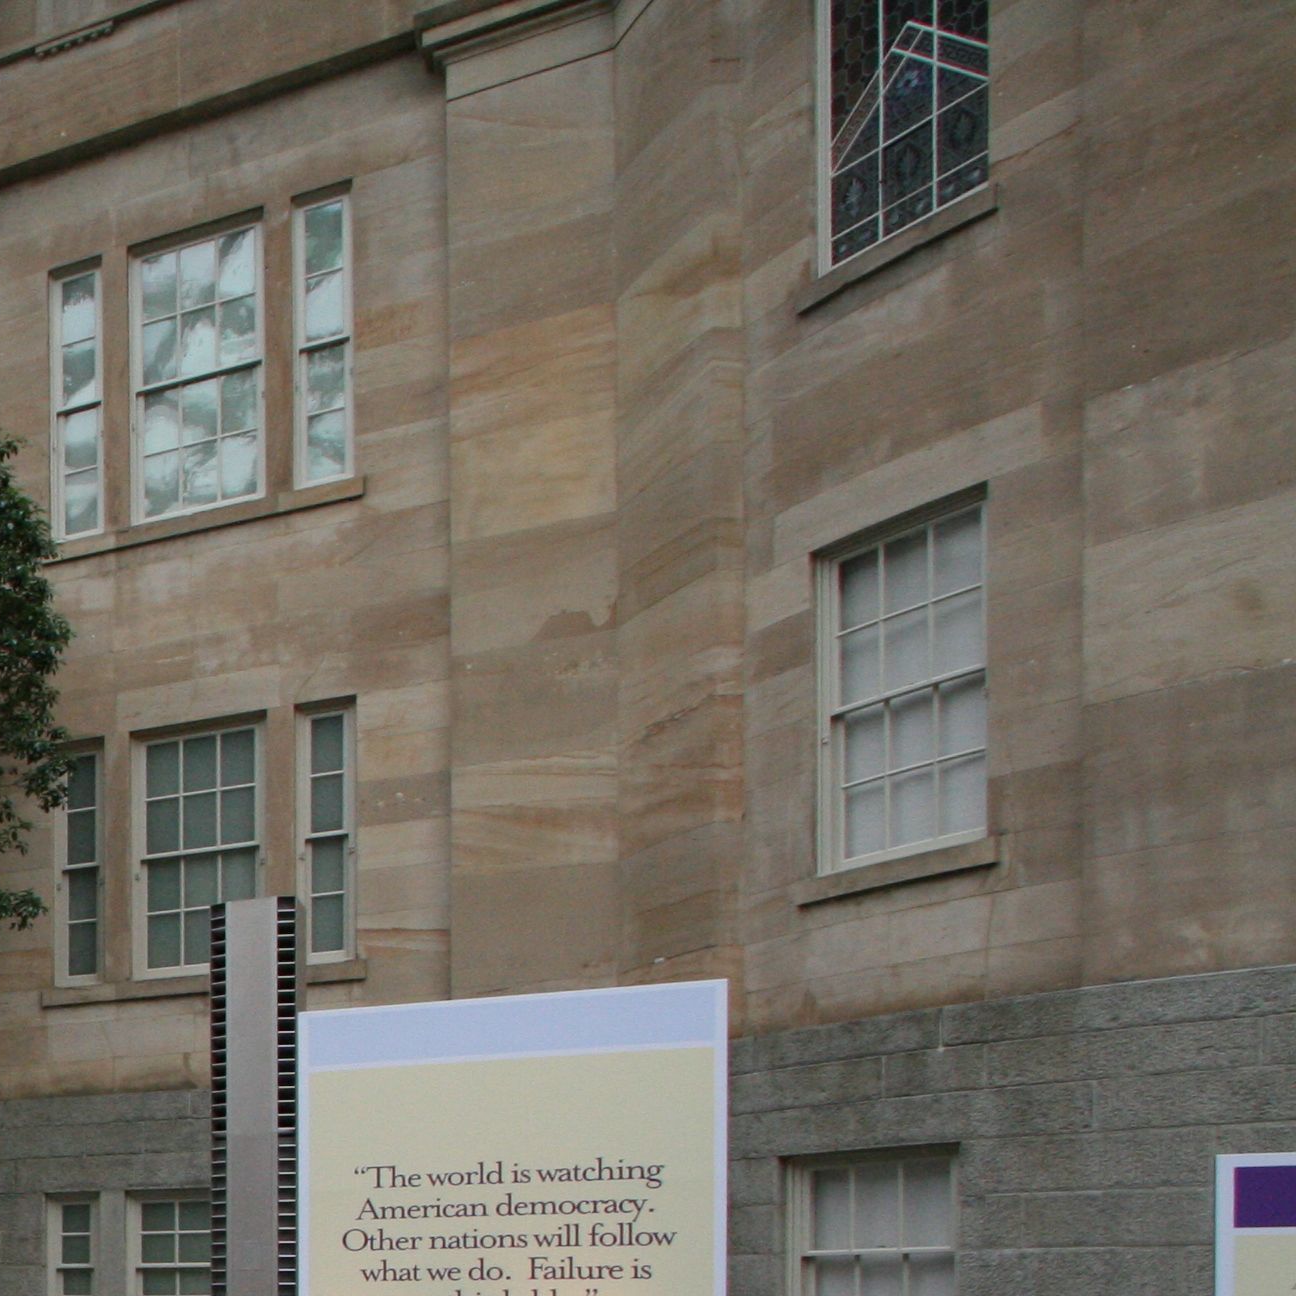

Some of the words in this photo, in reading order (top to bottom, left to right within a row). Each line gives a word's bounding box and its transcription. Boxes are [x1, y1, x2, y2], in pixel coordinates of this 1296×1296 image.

[354, 1165, 422, 1189] “The
[426, 1161, 504, 1187] world
[511, 1163, 532, 1184] is
[536, 1157, 665, 1189] watching
[355, 1198, 489, 1221] American
[496, 1193, 655, 1223] democracy.
[342, 1228, 423, 1252] Other
[429, 1228, 528, 1250] nations
[533, 1223, 581, 1248] will
[588, 1222, 678, 1247] follow
[360, 1259, 421, 1282] what
[426, 1266, 461, 1282] we
[468, 1258, 512, 1281] do.
[528, 1256, 624, 1280] Failure
[630, 1258, 652, 1279] is
